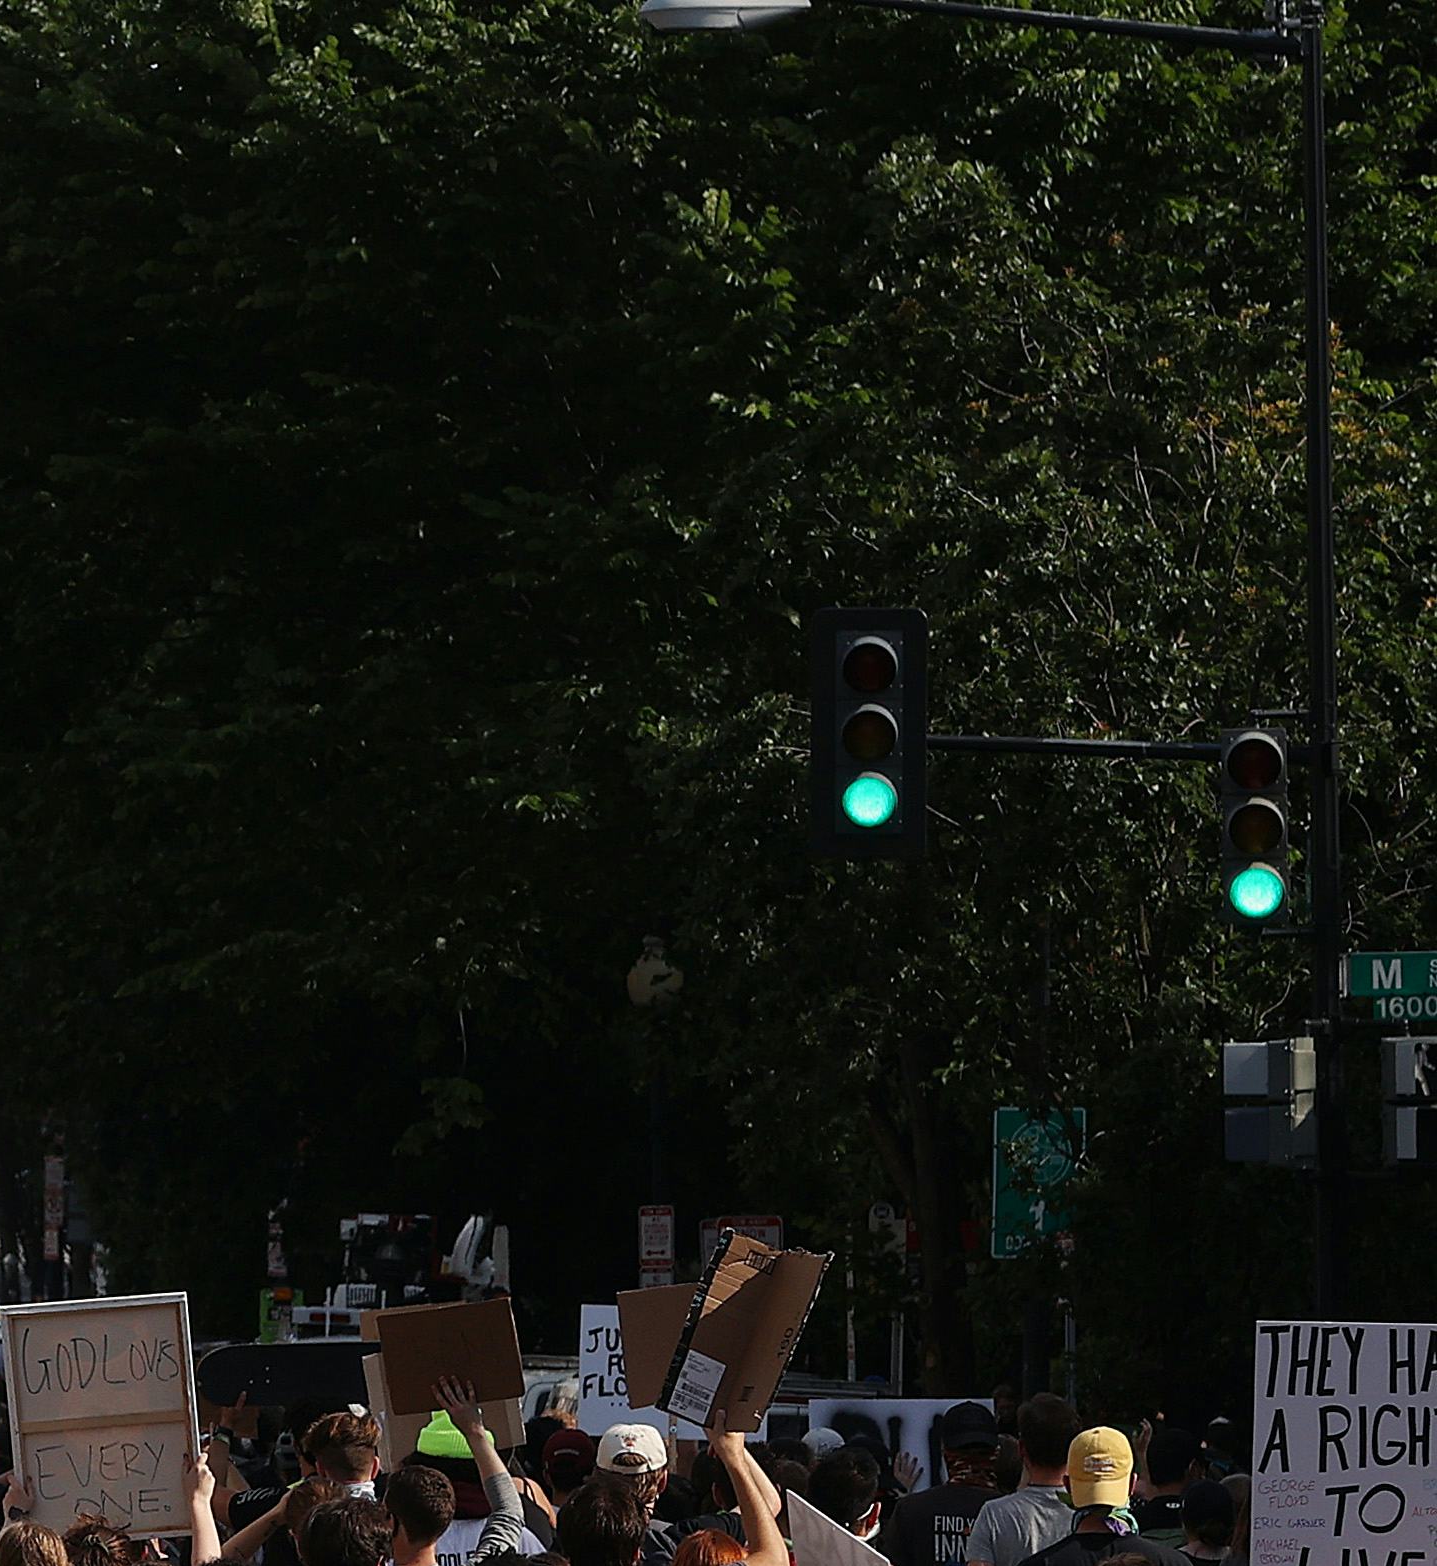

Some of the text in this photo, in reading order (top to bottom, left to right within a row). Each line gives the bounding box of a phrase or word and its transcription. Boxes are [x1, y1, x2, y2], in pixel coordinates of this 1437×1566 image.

[1372, 958, 1437, 989] M S
[1376, 996, 1437, 1018] 1600
[1260, 1325, 1364, 1398] THEY
[1258, 1404, 1437, 1474] A RIGH
[36, 1441, 165, 1501] EVERY
[1258, 1479, 1316, 1496] GEORGE
[1269, 1494, 1310, 1510] FLOYD
[1325, 1483, 1406, 1538] TO
[934, 1515, 964, 1532] FIND
[1253, 1516, 1282, 1530] ERIC
[1254, 1537, 1301, 1553] MICHAEL
